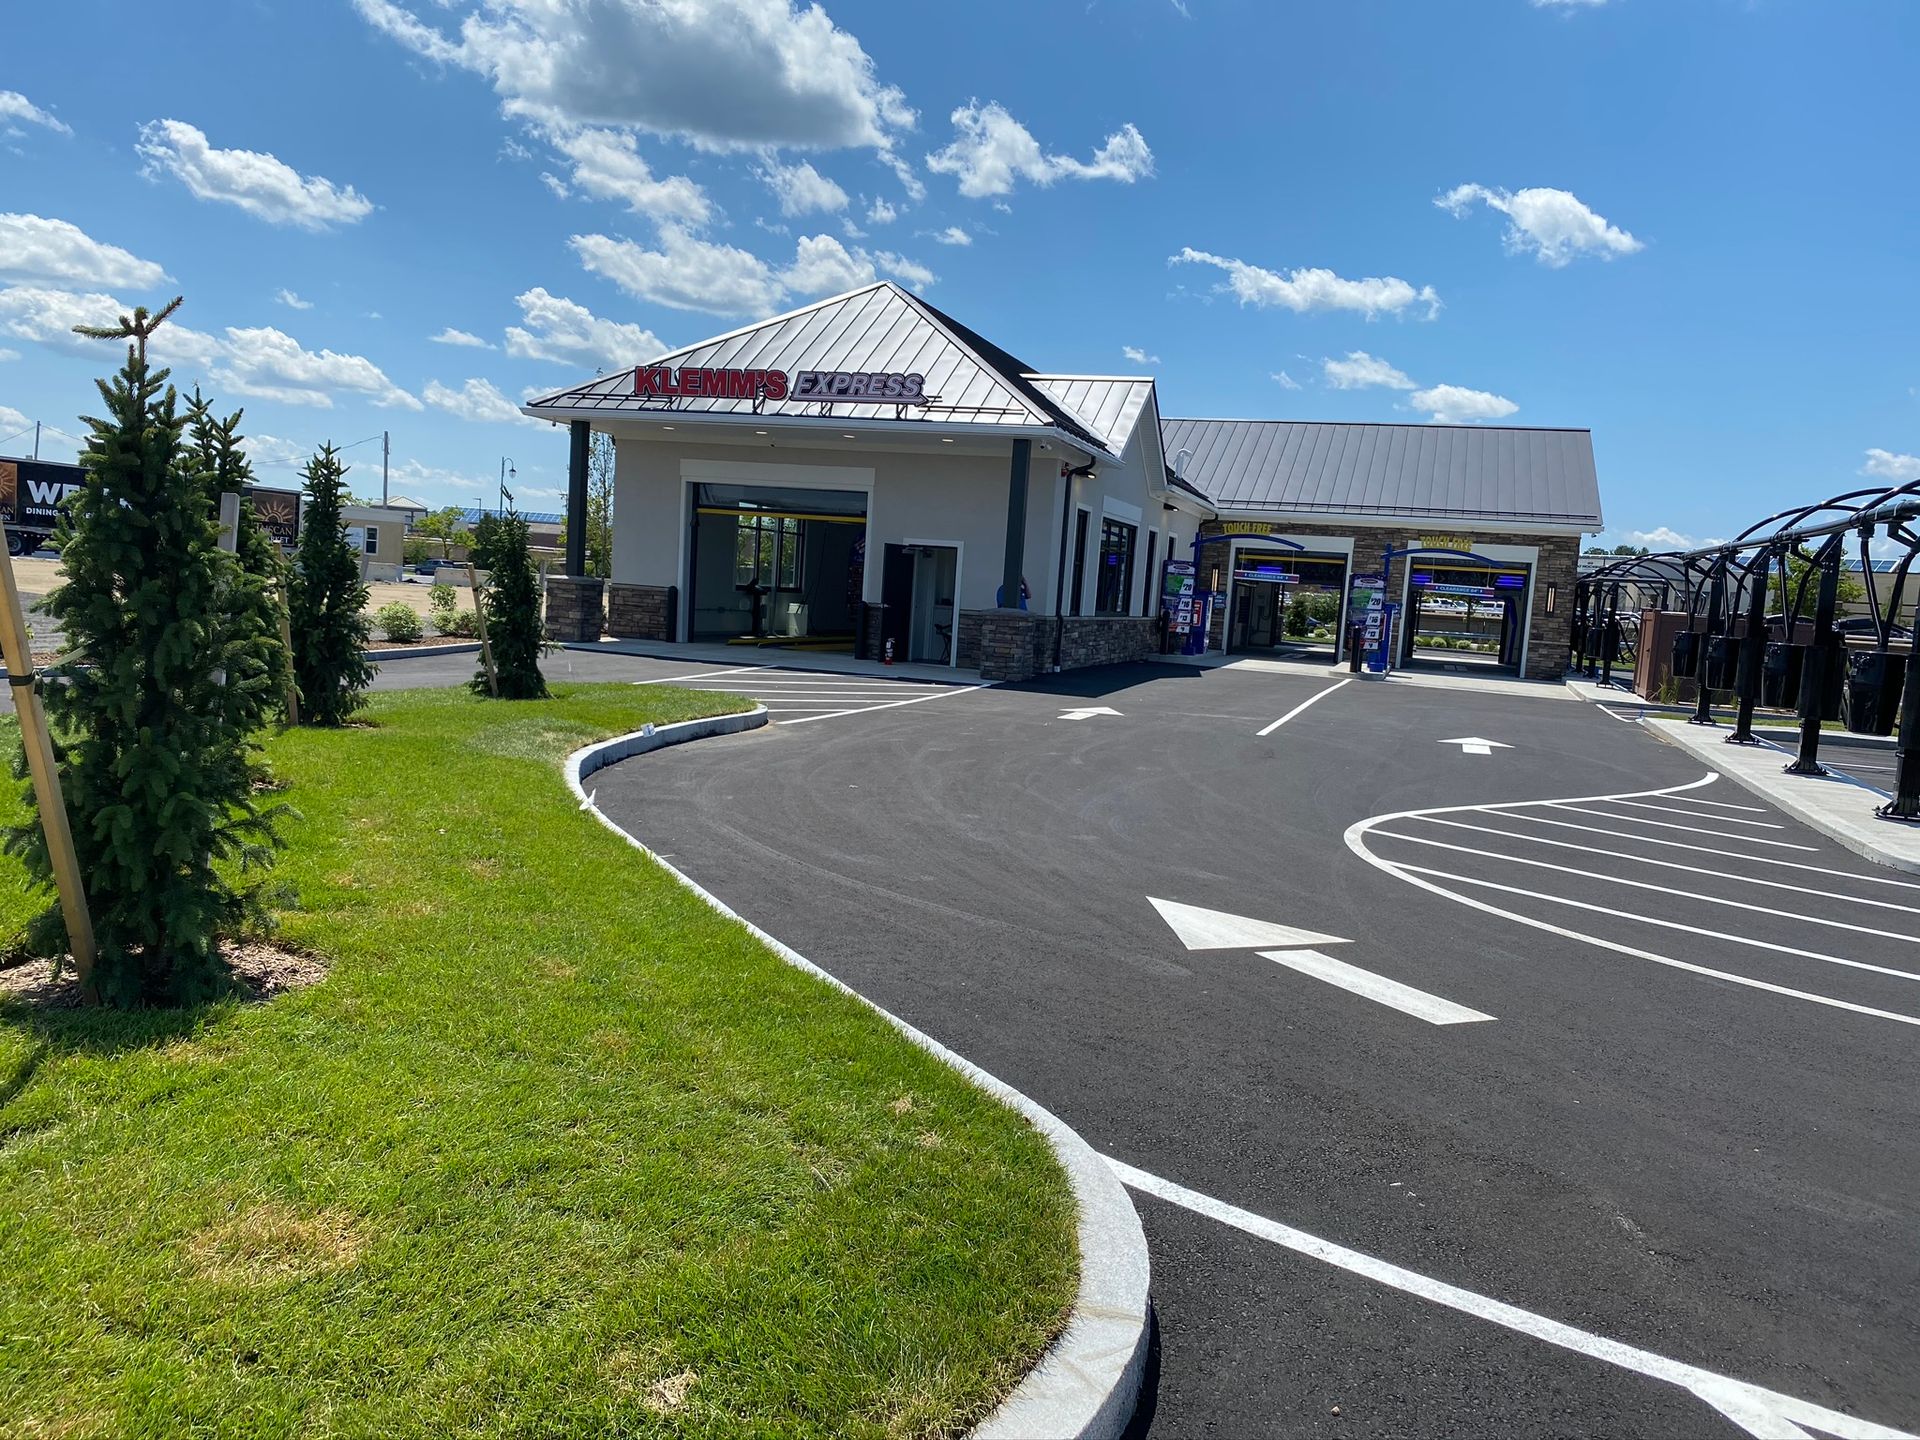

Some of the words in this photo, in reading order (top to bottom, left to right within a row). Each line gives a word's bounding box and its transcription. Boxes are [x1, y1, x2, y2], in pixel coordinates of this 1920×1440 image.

[635, 366, 788, 400] KLEMM'S
[793, 372, 924, 397] EXPRESS
[26, 507, 60, 517] DINING
[1222, 522, 1250, 534] TOUCH
[1252, 523, 1273, 535] FREE
[1420, 535, 1449, 548] TOUCH
[1452, 537, 1473, 552] FREE
[1182, 583, 1192, 591] $20
[1371, 597, 1381, 606] $20
